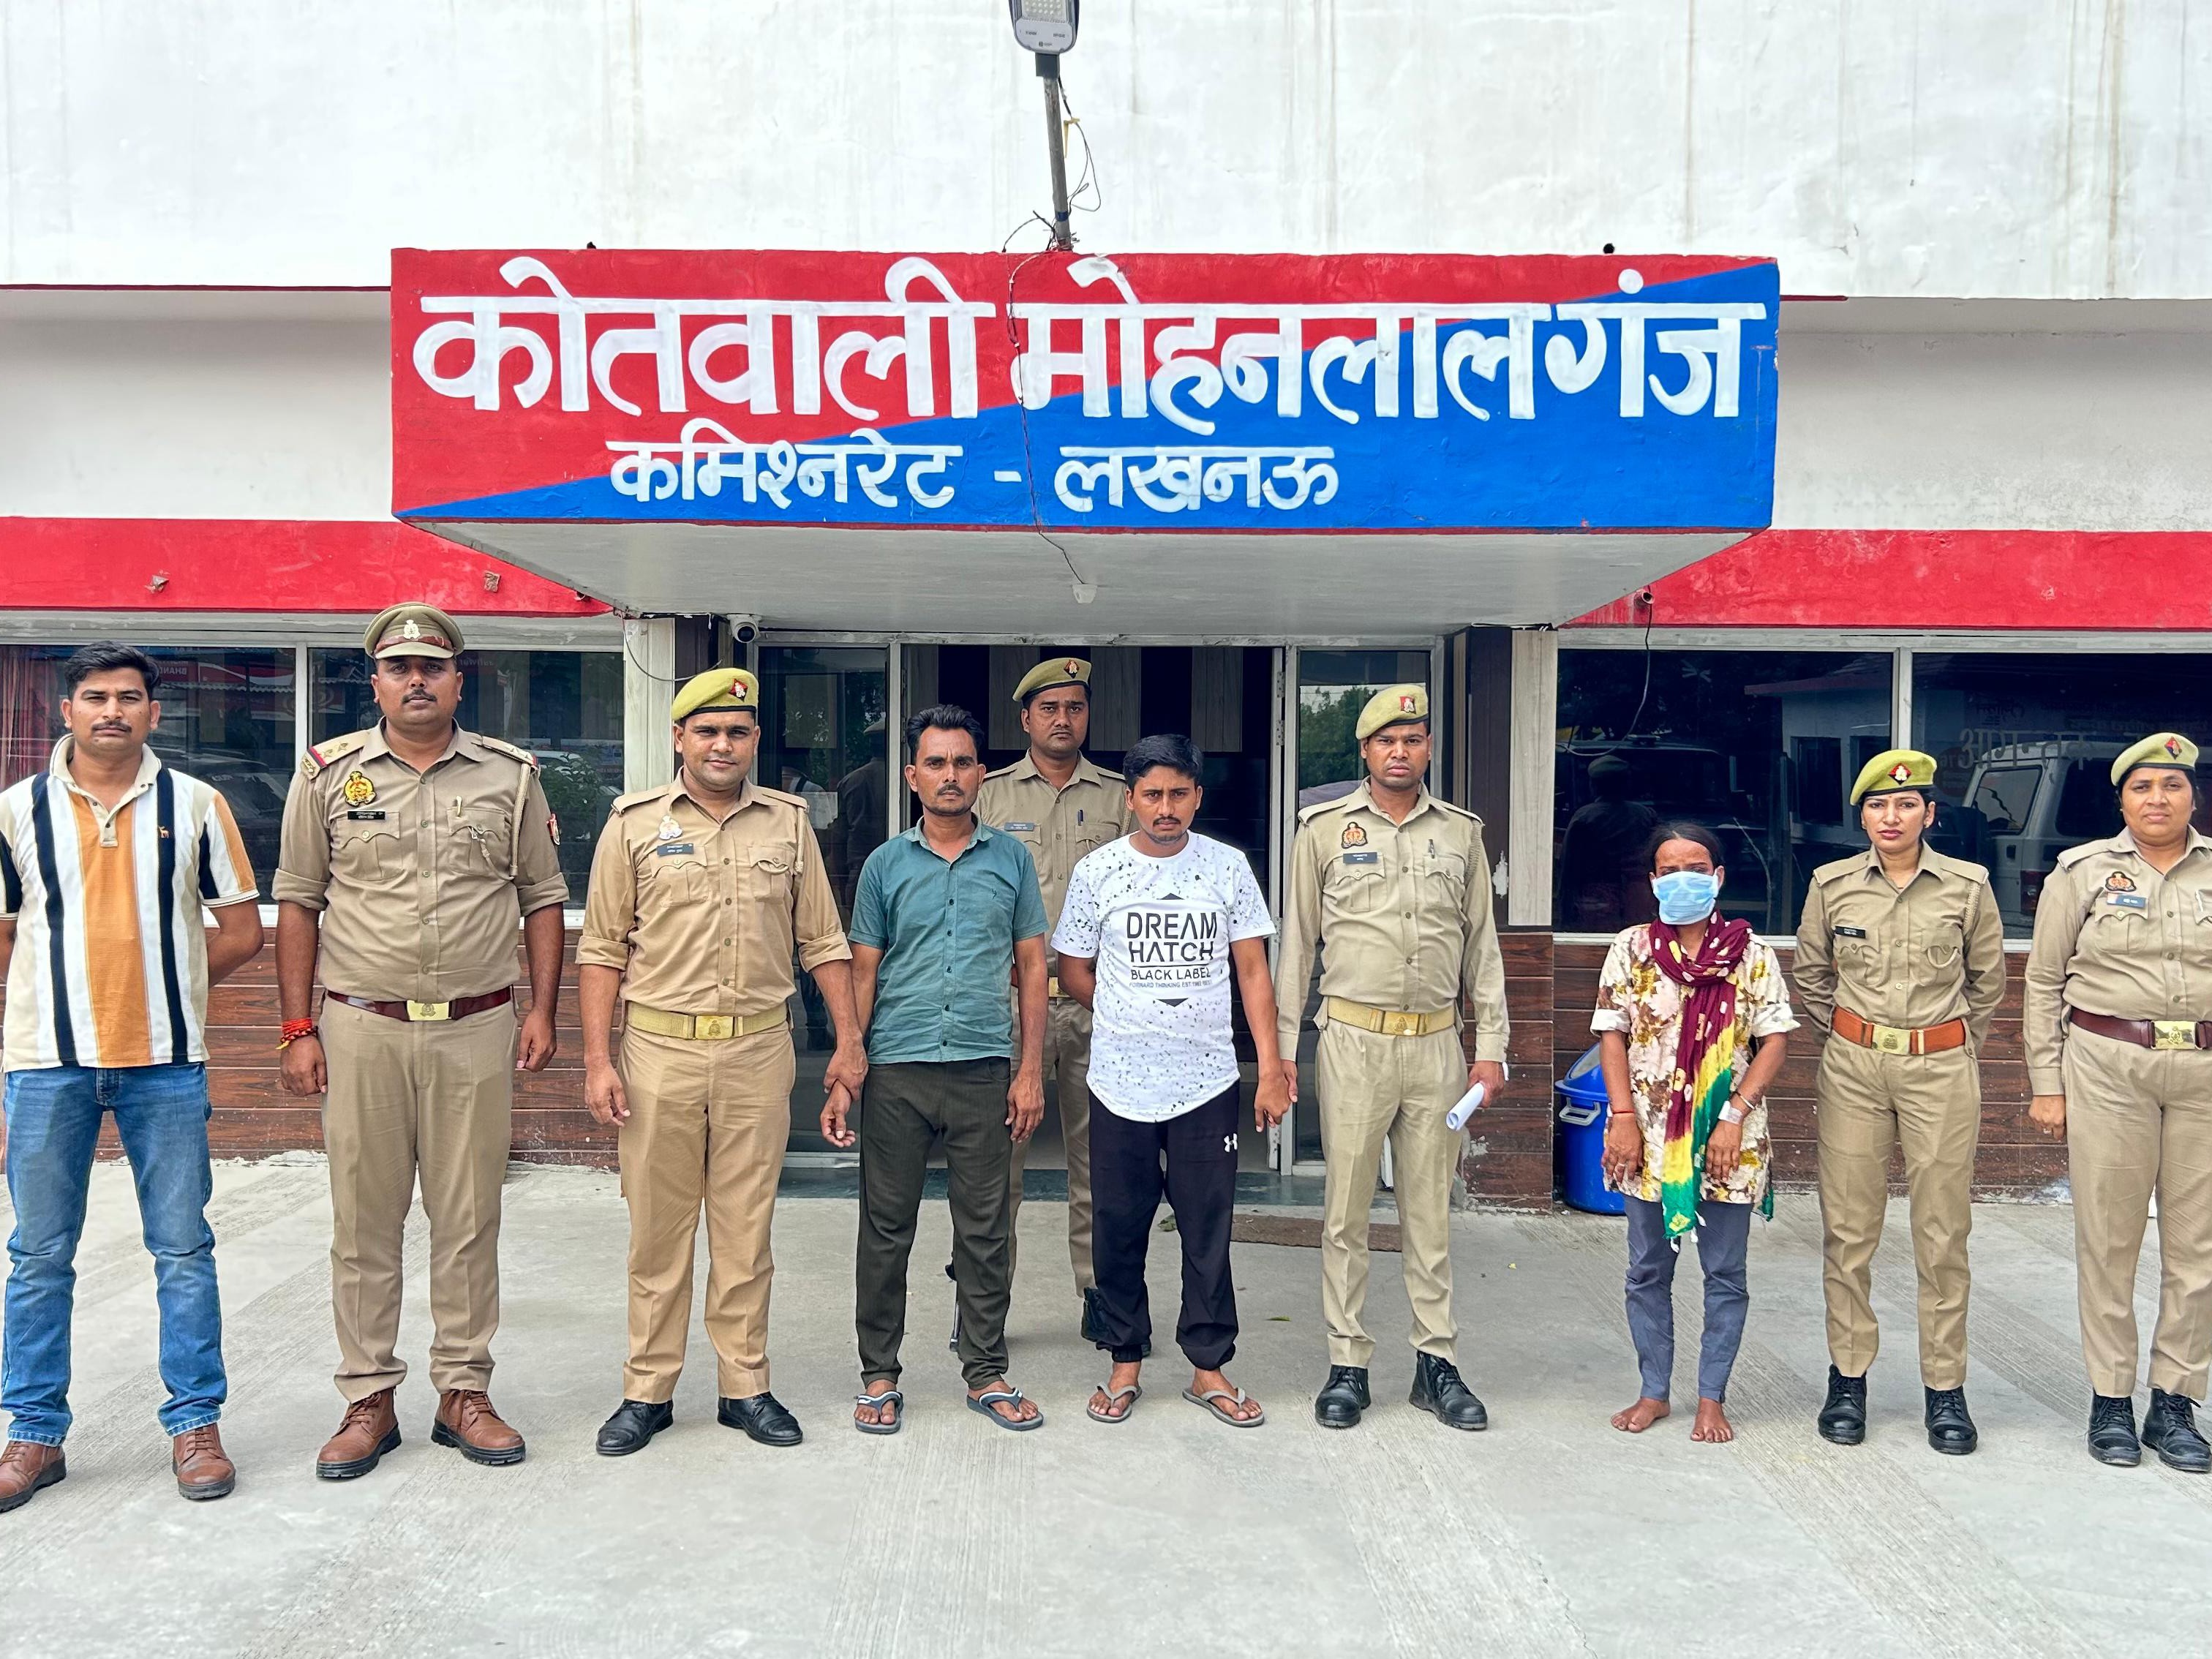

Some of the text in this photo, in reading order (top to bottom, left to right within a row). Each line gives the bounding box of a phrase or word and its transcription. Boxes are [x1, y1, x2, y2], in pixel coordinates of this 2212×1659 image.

[413, 256, 1766, 435] कोतवाली मोहनलालगंज
[605, 417, 1339, 513] कमिश्नरेट - लखनऊ
[1126, 911, 1217, 940] DREAM
[1128, 941, 1214, 963] HATCH
[1130, 966, 1211, 981] BLACK LABEL
